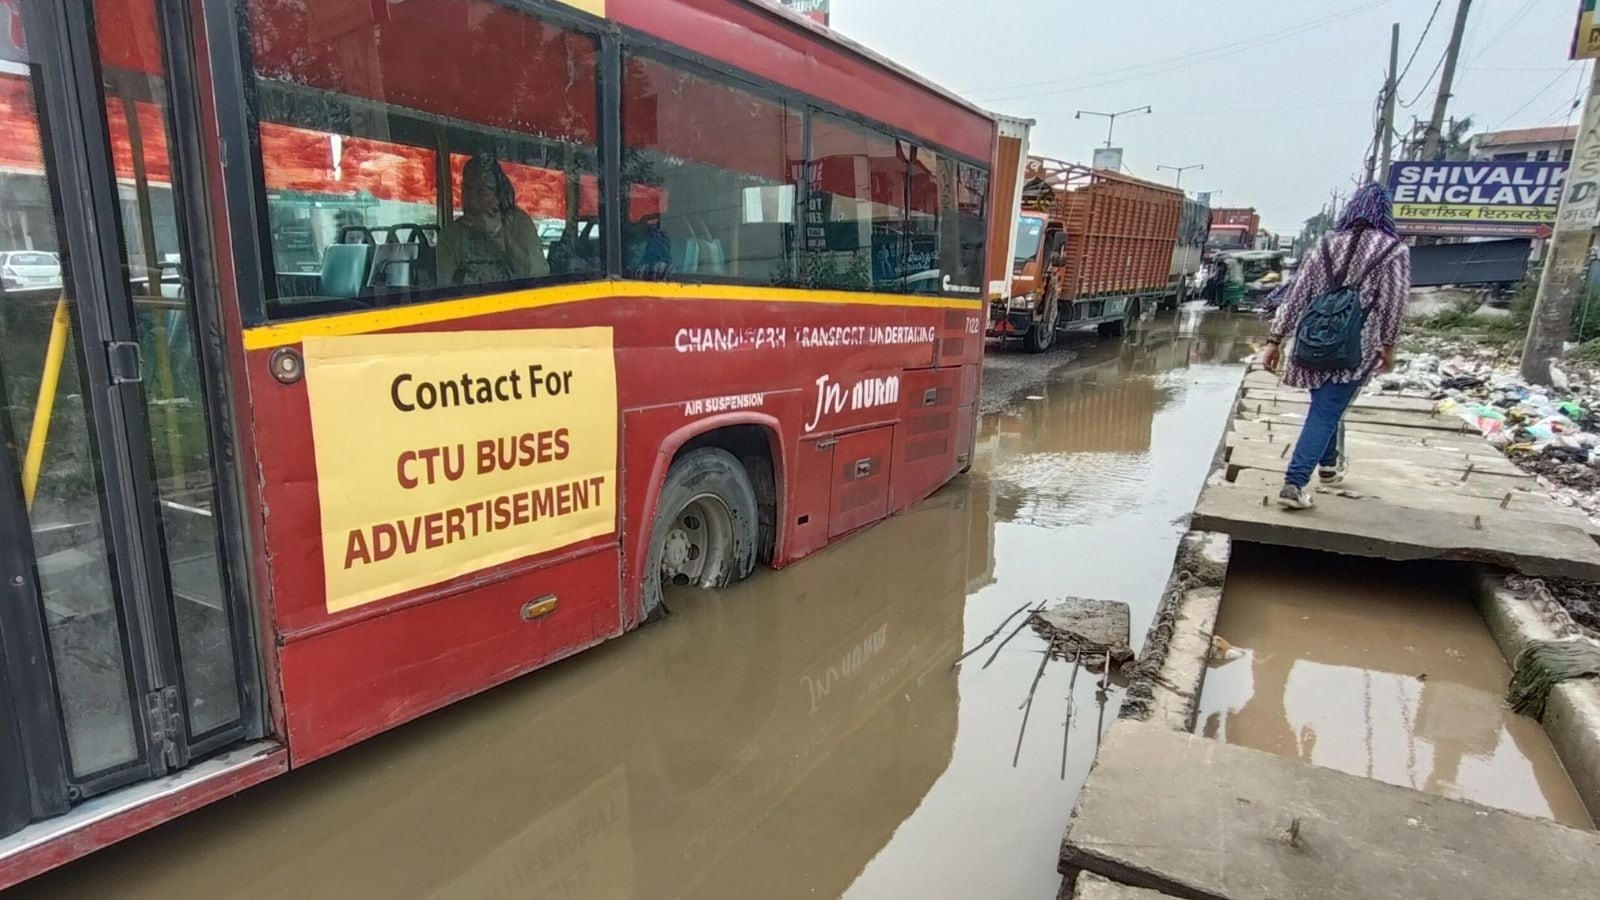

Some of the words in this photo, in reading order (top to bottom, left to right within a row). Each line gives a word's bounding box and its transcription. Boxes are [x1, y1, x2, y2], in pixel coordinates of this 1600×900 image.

[1398, 166, 1567, 185] SHIVALIK
[1393, 185, 1560, 204] ENCLAVE
[390, 368, 523, 413] Contact
[528, 364, 573, 399] For
[685, 400, 703, 416] AIR
[705, 394, 764, 412] SUSPENSION
[396, 443, 465, 490] CTU
[476, 427, 570, 475] BUSES
[343, 476, 605, 570] ADVERTISEMENT
